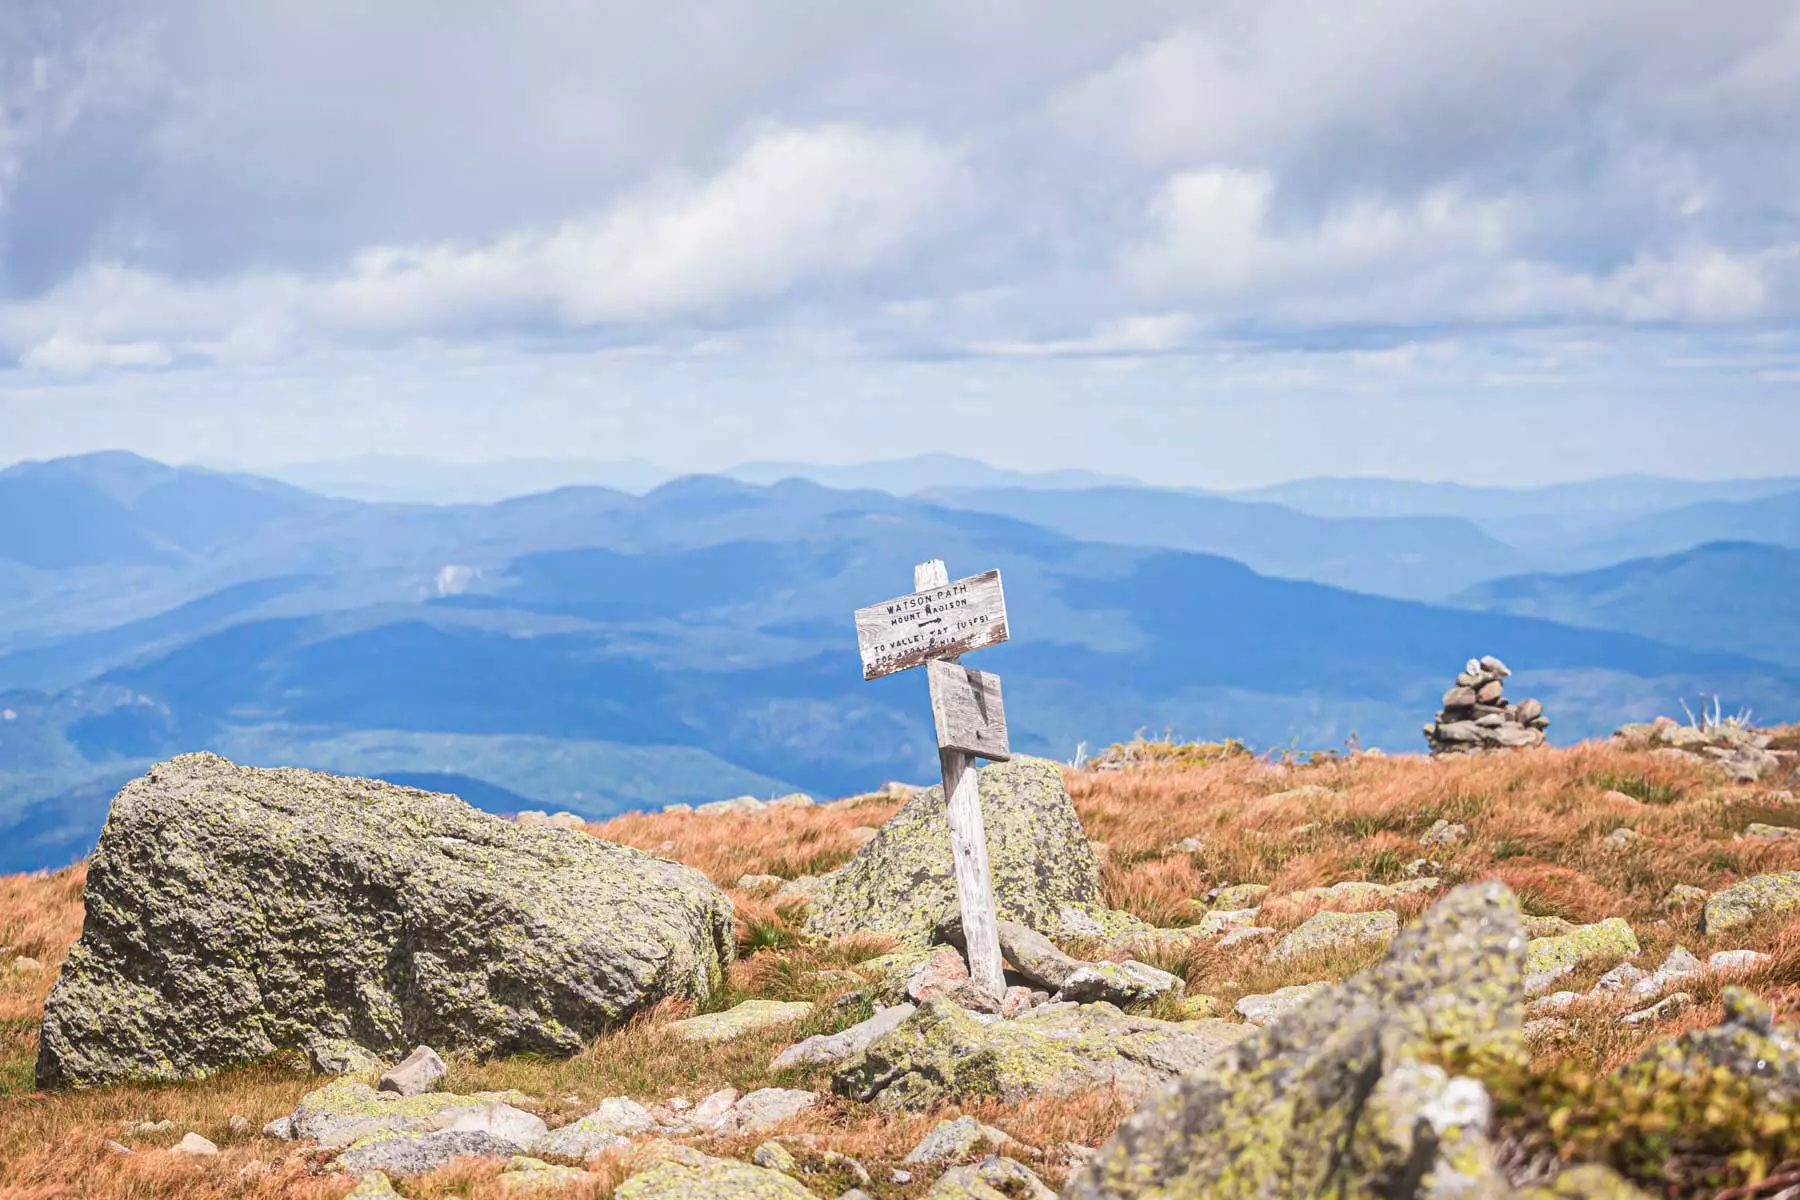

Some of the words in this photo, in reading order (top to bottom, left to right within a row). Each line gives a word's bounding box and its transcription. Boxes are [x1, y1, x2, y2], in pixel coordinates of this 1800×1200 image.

[886, 594, 932, 615] WATSON
[937, 584, 967, 599] PATH
[890, 612, 920, 626] MOUNT
[925, 598, 967, 616] MADISON
[874, 644, 885, 653] TO
[876, 654, 892, 664] FOR
[896, 636, 956, 658] APPALHIA
